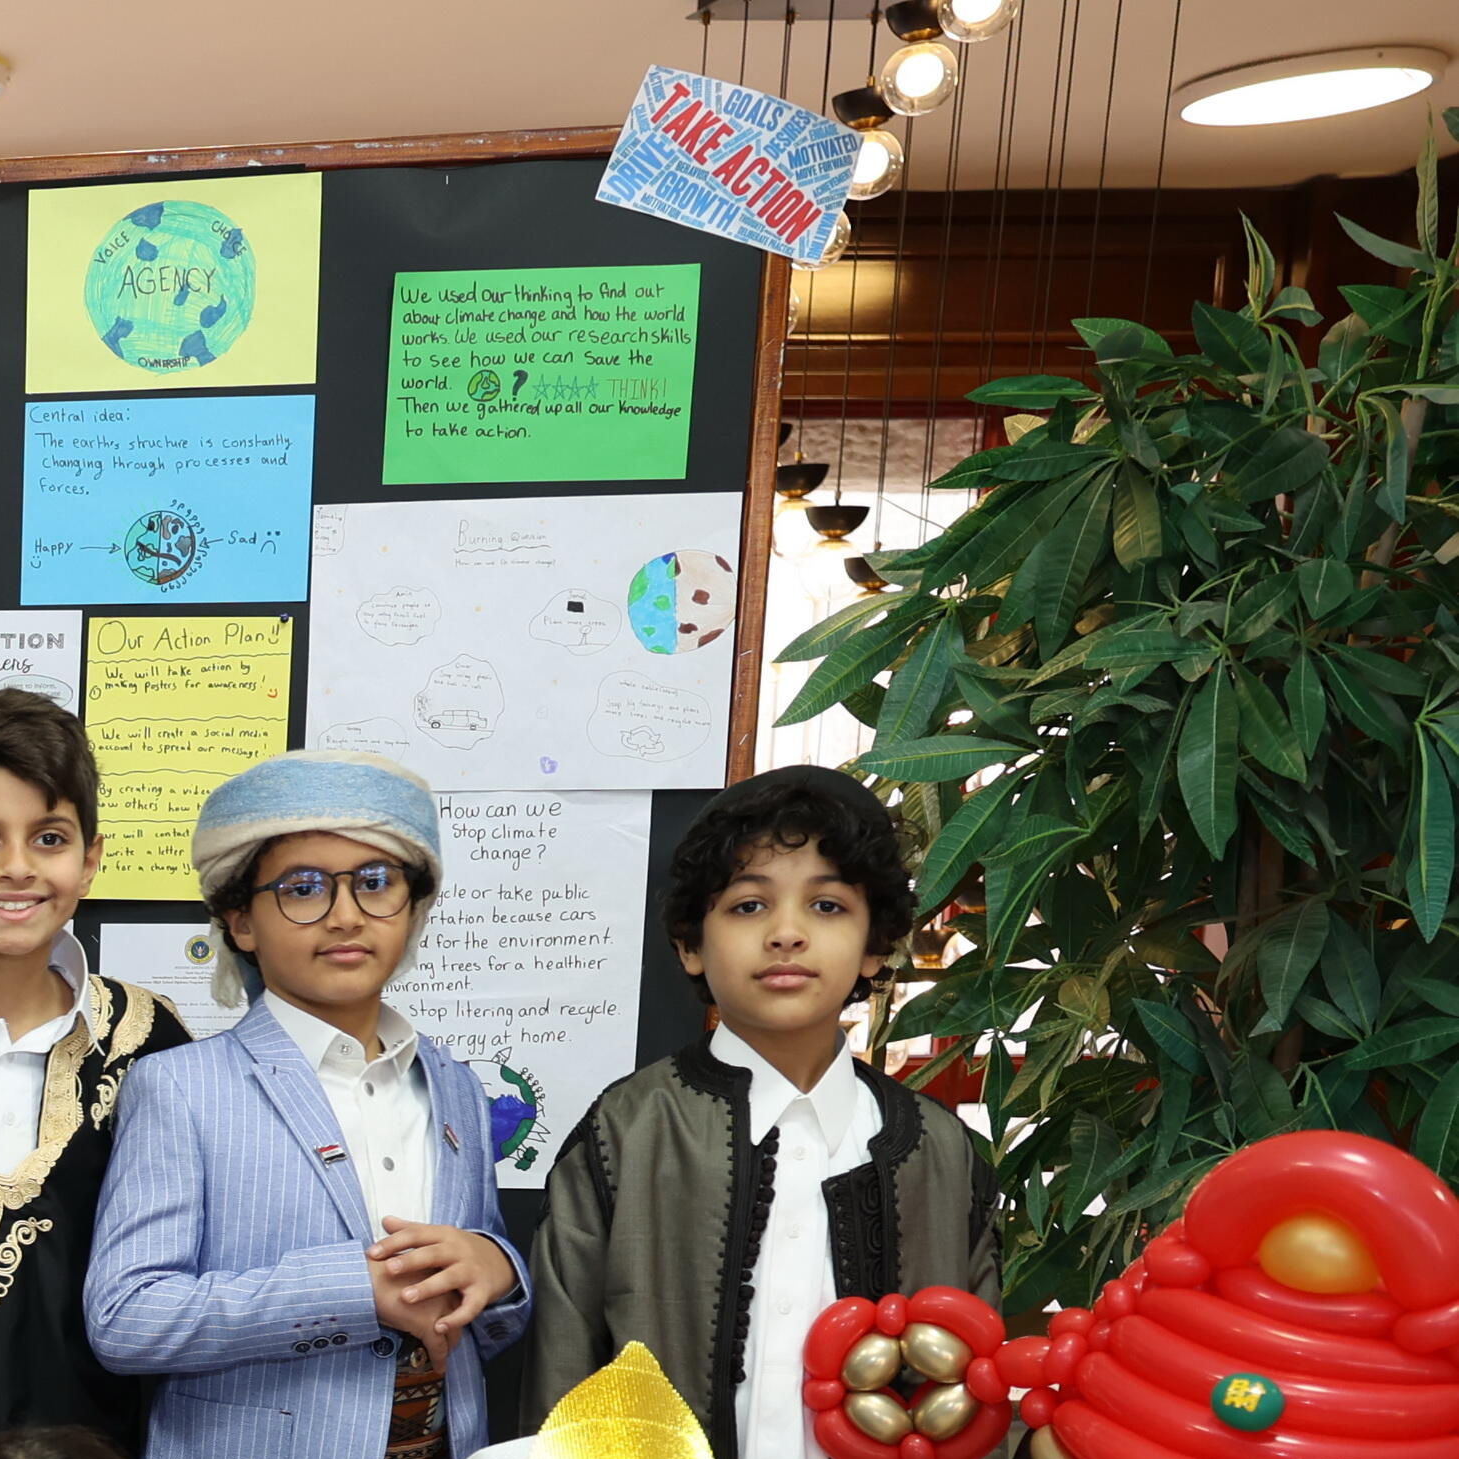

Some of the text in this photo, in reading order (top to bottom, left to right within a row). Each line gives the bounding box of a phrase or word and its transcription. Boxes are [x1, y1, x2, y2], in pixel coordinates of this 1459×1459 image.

[723, 89, 784, 131] GOALS
[763, 110, 811, 160] DESIRES
[651, 82, 822, 245] TAKE ACTION
[788, 133, 857, 169] MOTIVATED
[606, 134, 674, 202] DRIVE
[656, 171, 741, 232] GROWTH
[94, 220, 247, 265] VOICE CHOICE
[118, 266, 215, 299] AGENCY
[400, 281, 665, 310] We used our thinking to find out
[402, 303, 686, 330] about climate change and how the world
[401, 325, 692, 346] works. We used our research skills
[138, 356, 191, 369] OWNERSHIP
[402, 349, 422, 368] to
[429, 354, 462, 369] see
[470, 349, 506, 369] how
[513, 351, 536, 365] we
[542, 351, 574, 364] can
[627, 348, 654, 367] the
[401, 375, 453, 391] world.
[28, 405, 131, 424] Central idea:
[396, 396, 440, 414] Then
[445, 401, 470, 414] we
[476, 396, 542, 421] gathered
[544, 403, 563, 417] up
[564, 400, 583, 414] all
[588, 403, 615, 415] our
[34, 432, 64, 449] The
[128, 434, 189, 451] structure
[199, 438, 214, 449] is
[221, 433, 294, 451] constantly
[405, 419, 532, 440] to take action.
[41, 451, 289, 481] changing through processes and
[34, 529, 257, 557] Happy Sad
[97, 620, 144, 655] Our
[153, 626, 211, 652] Action
[105, 666, 124, 680] We
[134, 665, 160, 680] will
[200, 662, 232, 674] action
[240, 659, 251, 676] by
[439, 795, 562, 820] How can we
[491, 821, 558, 840] climate
[470, 882, 590, 908] or take public
[491, 905, 597, 924] because cars
[436, 926, 614, 951] for the environment.
[441, 954, 608, 973] trees for a healthier
[456, 999, 514, 1027] litering
[517, 997, 551, 1018] and
[559, 999, 621, 1025] recycle.
[491, 1031, 513, 1048] at
[521, 1028, 572, 1044] home.
